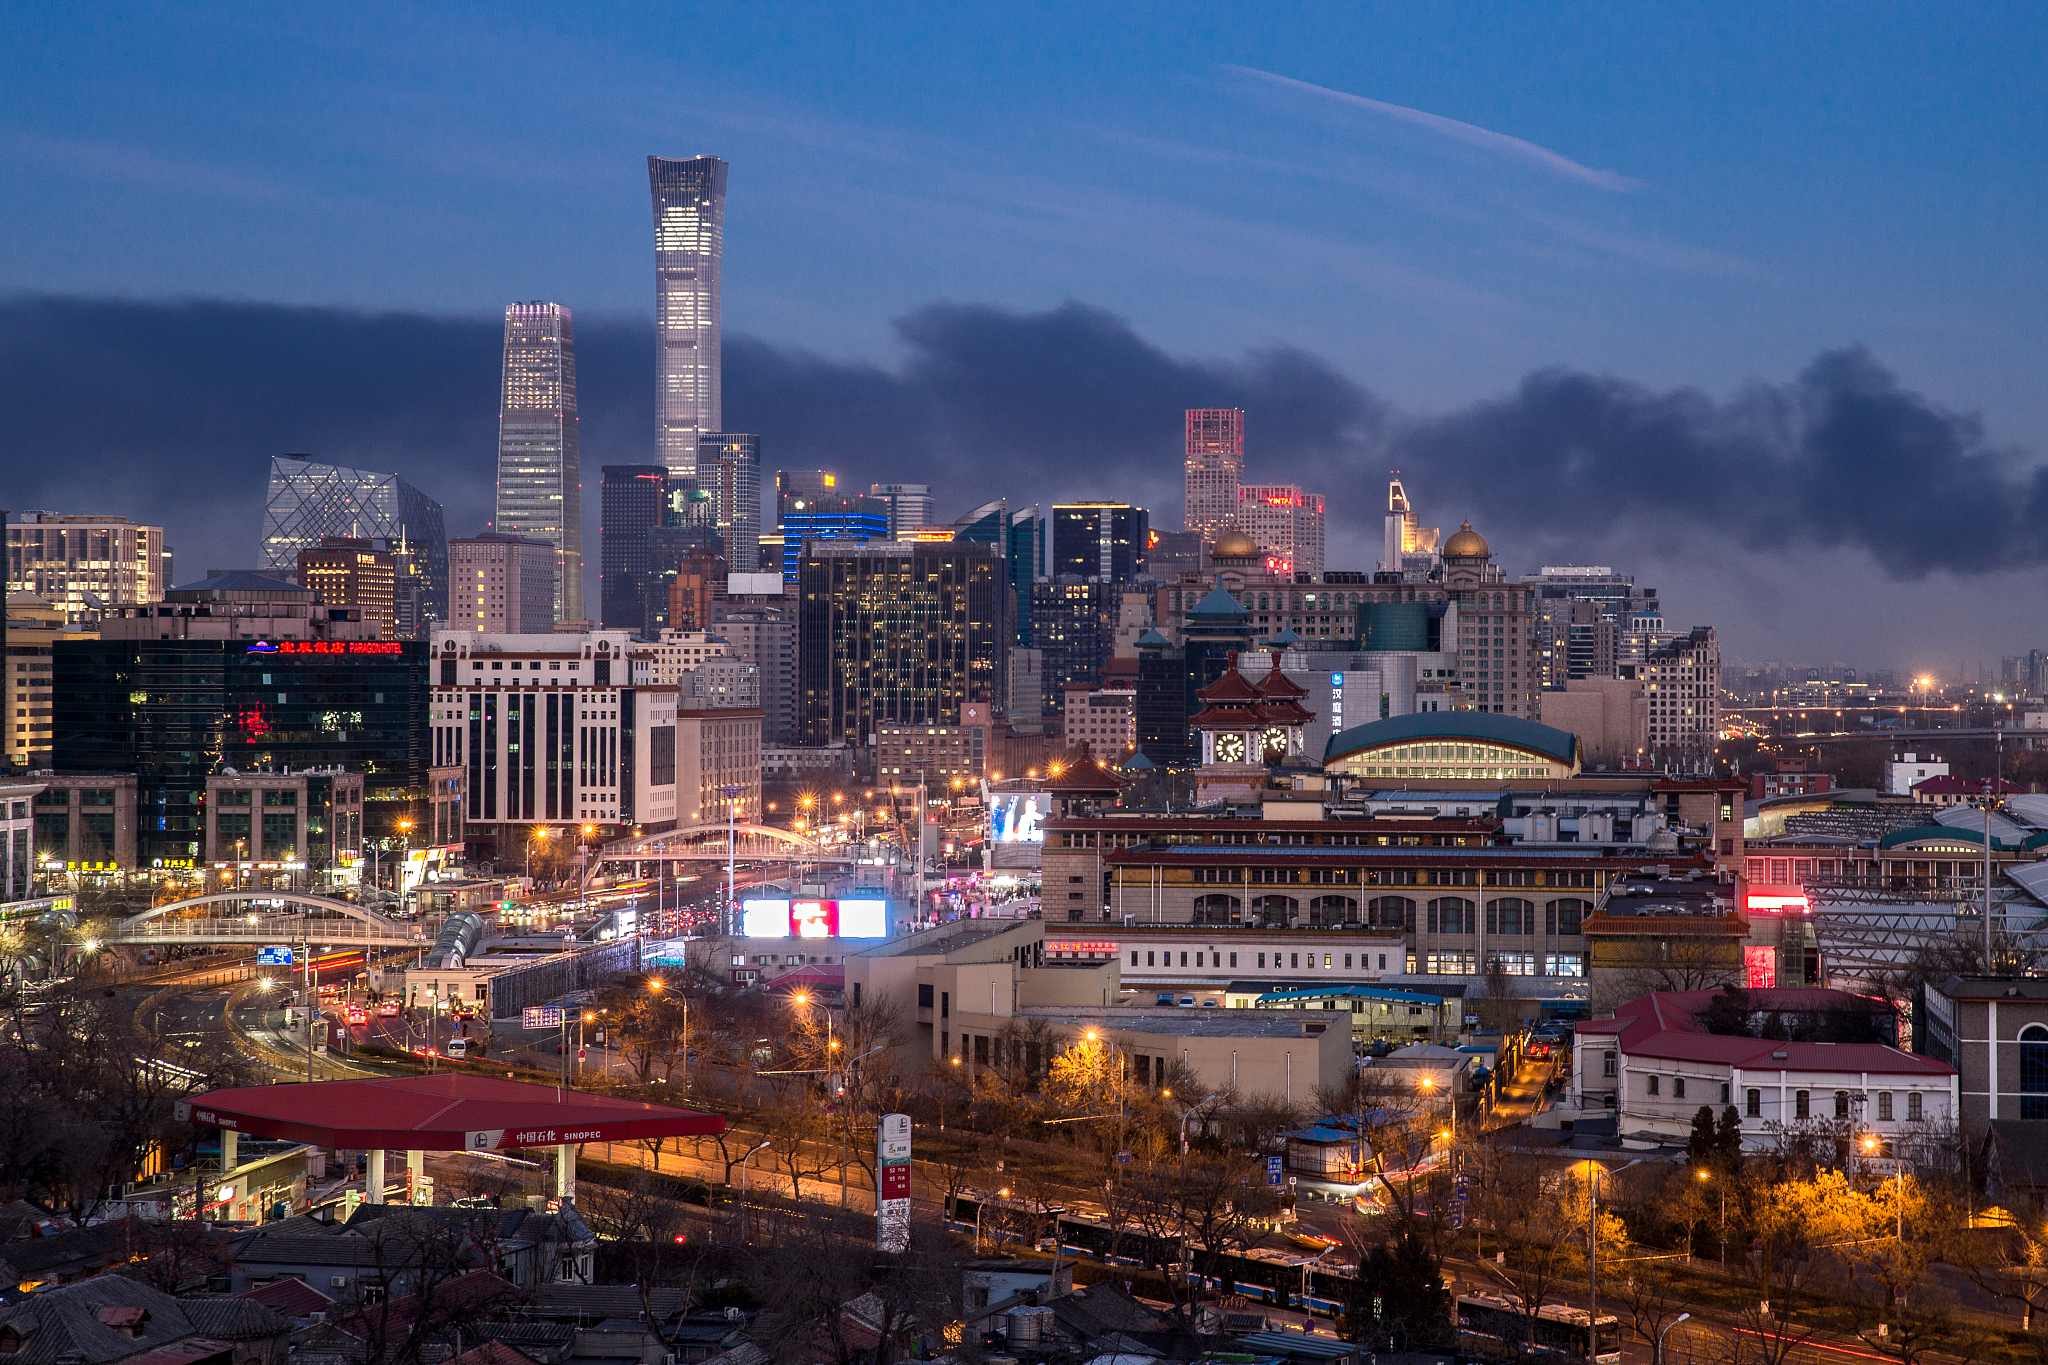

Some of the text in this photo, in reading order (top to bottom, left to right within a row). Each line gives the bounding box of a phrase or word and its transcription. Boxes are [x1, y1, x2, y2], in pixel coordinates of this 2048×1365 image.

[1267, 497, 1293, 505] YINTAI
[279, 641, 346, 654] 宝辰饭店
[349, 642, 403, 654] PARAGON HOTEL
[218, 1117, 237, 1127] SINOPEC
[516, 1130, 557, 1143] 中国石化
[564, 1131, 601, 1140] SINOPEC
